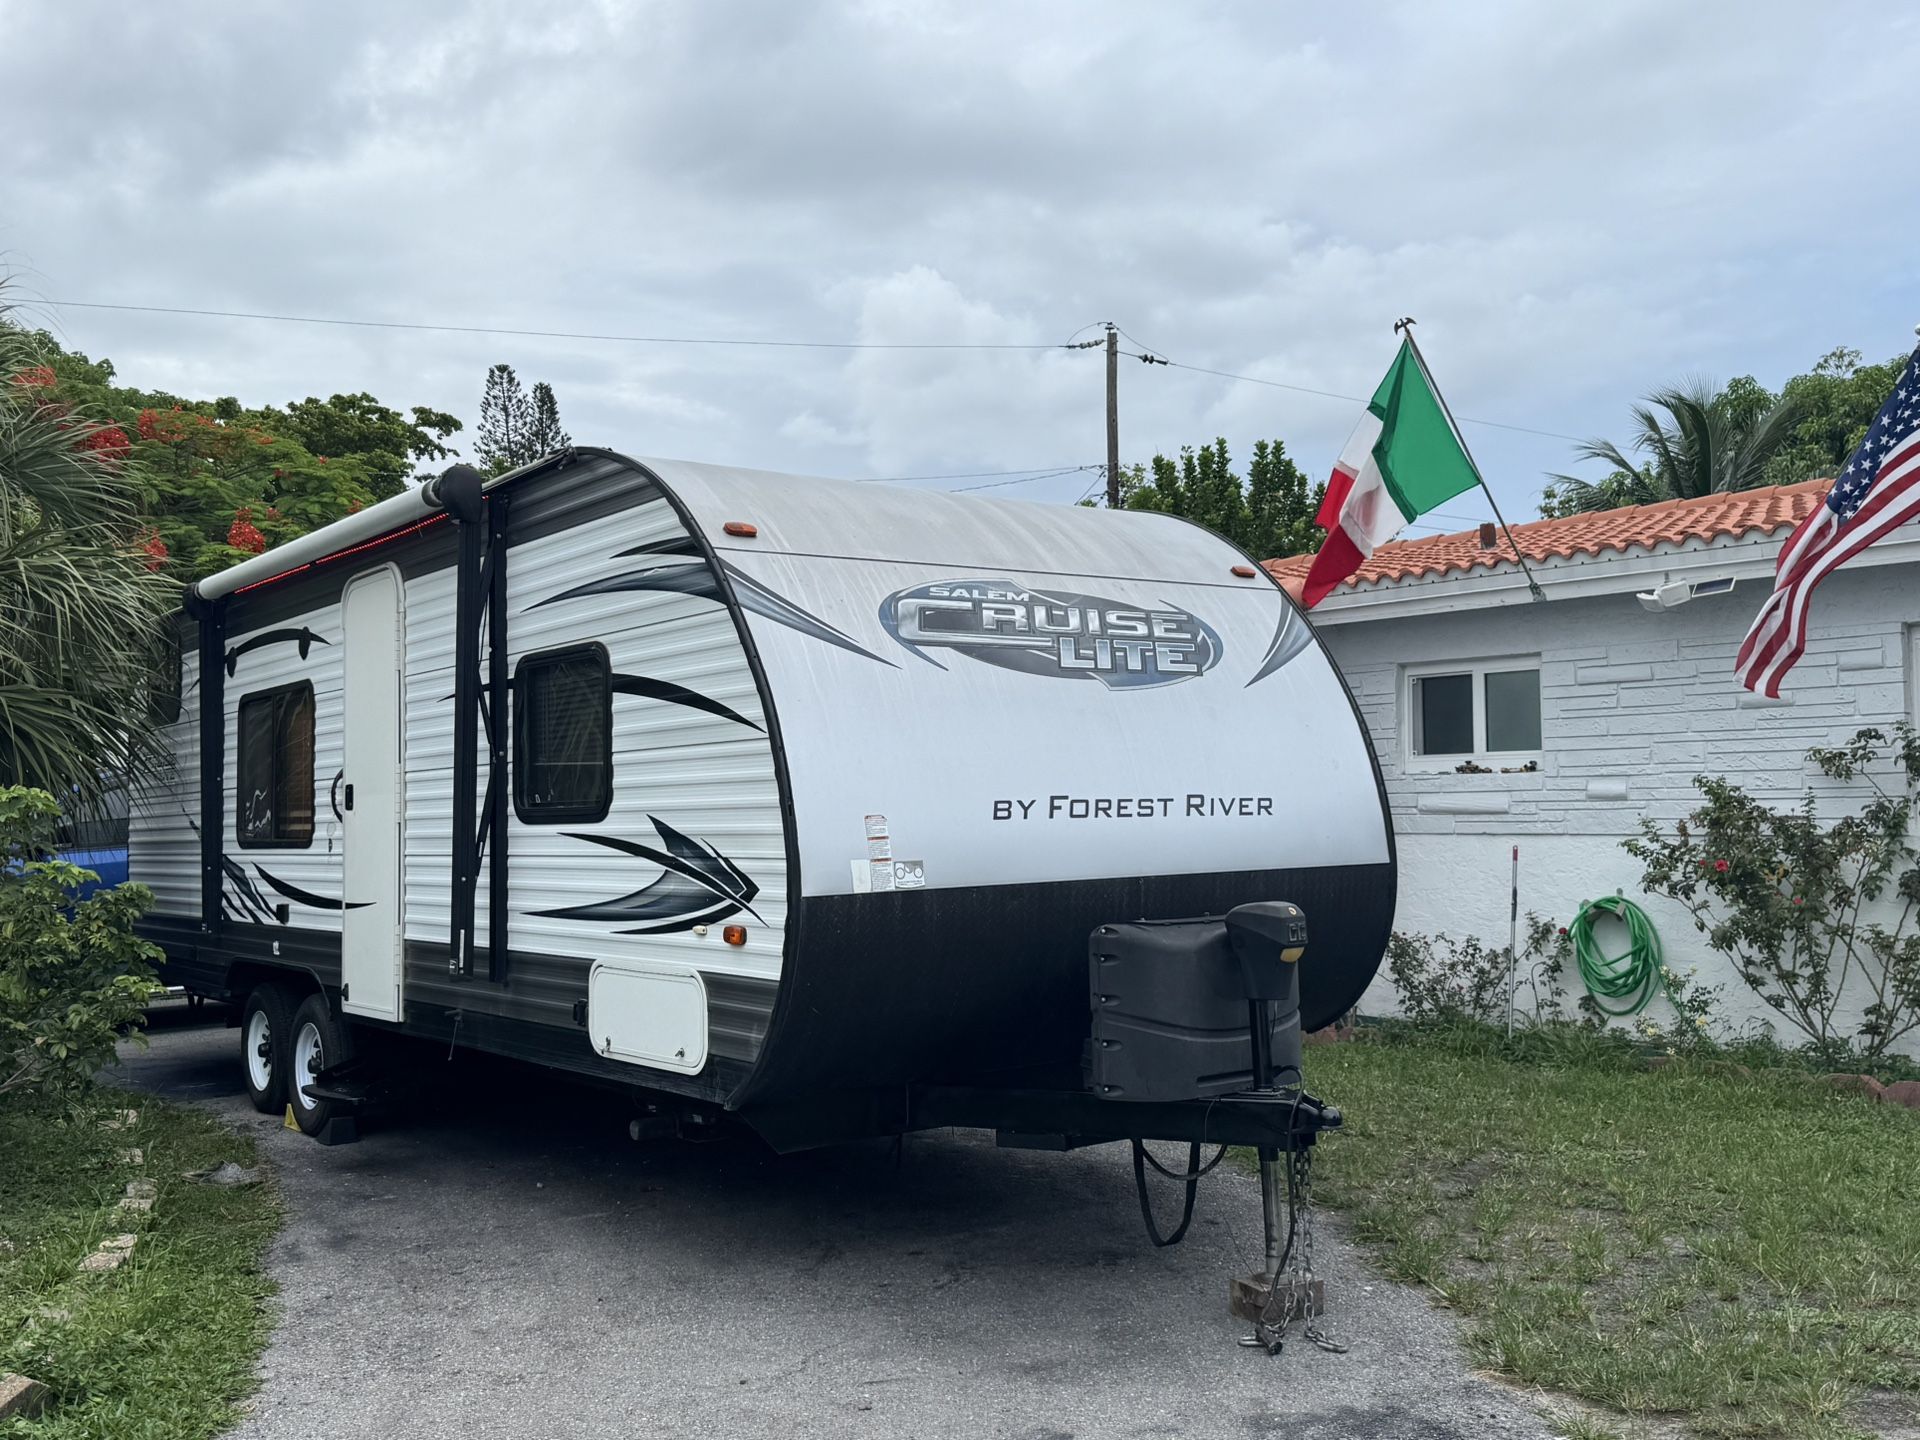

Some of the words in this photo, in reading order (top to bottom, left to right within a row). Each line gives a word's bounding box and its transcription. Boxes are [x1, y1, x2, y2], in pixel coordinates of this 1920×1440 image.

[929, 586, 1030, 602] SALEM
[897, 598, 1192, 647] CRUISE
[1058, 637, 1200, 673] LITE
[992, 799, 1037, 820] BY
[1048, 795, 1174, 819] FOREST
[1185, 794, 1274, 817] RIVER
